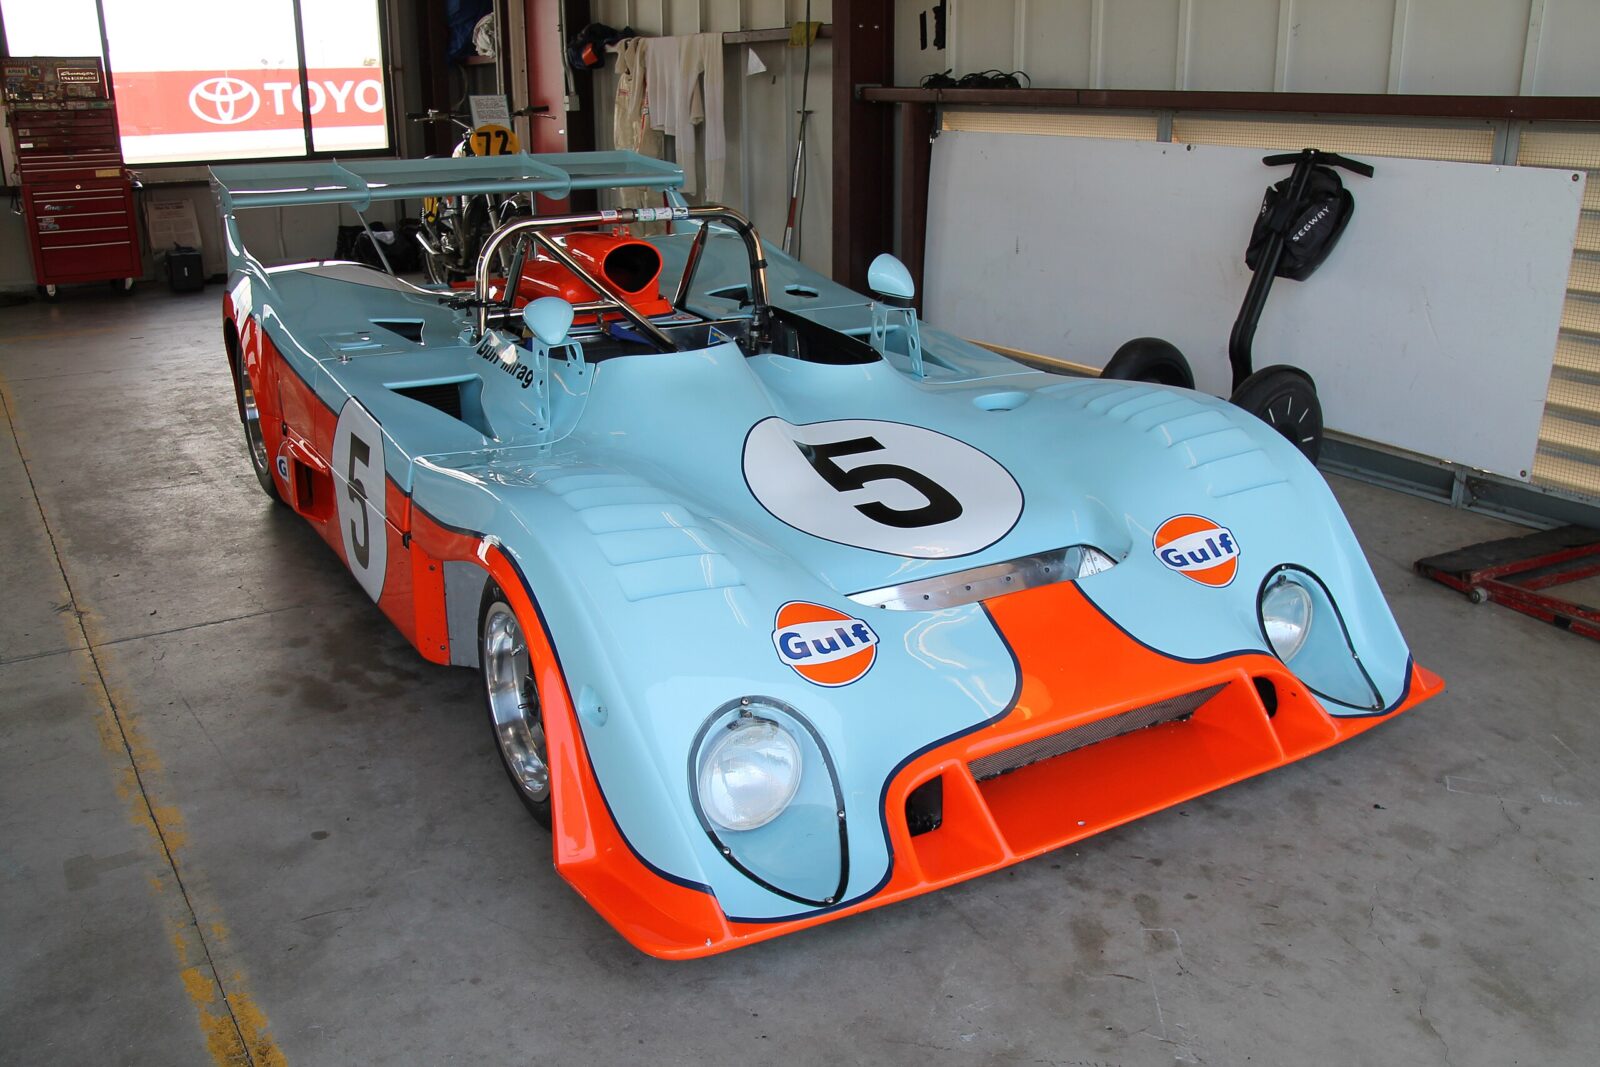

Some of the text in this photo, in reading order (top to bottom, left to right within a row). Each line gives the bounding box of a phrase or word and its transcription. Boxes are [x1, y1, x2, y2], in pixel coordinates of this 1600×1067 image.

[477, 130, 512, 156] 72
[1292, 205, 1330, 242] SEGWAY
[794, 436, 963, 527] 5
[348, 431, 371, 570] 5
[1160, 533, 1234, 567] Gulf
[779, 623, 870, 660] Gulf
